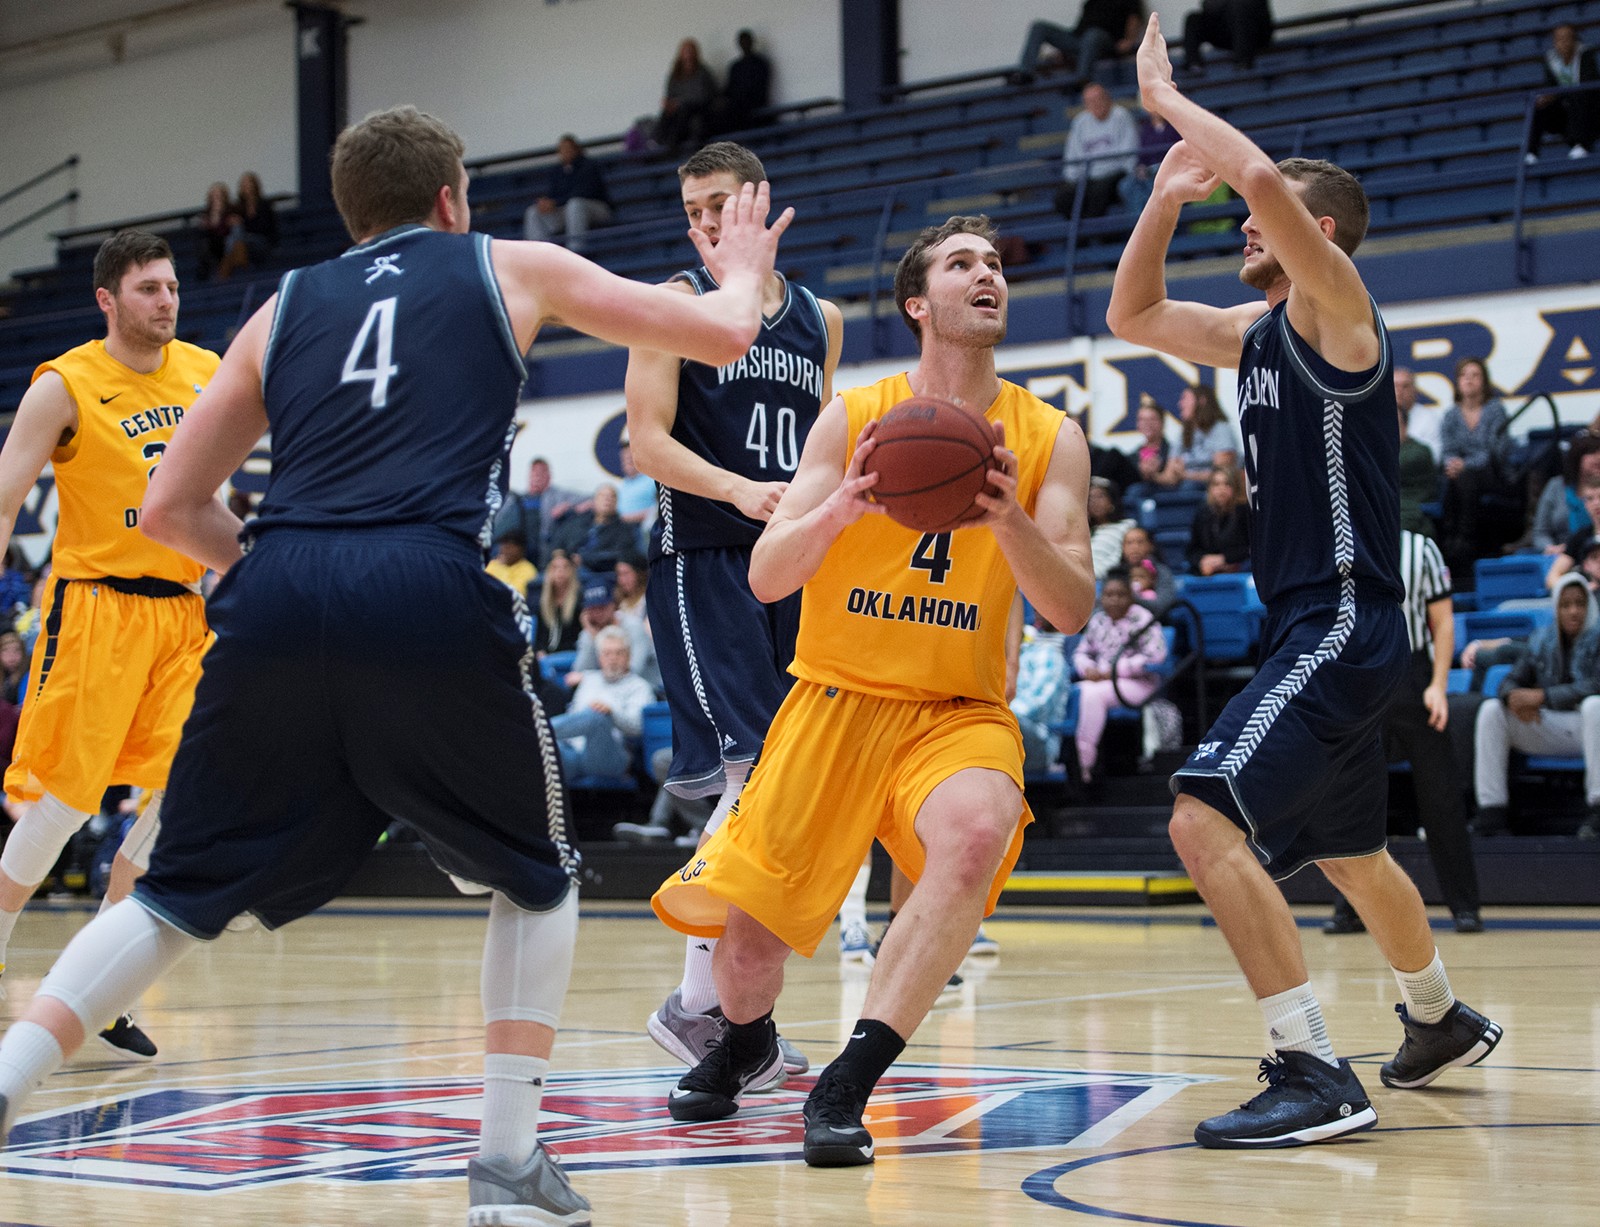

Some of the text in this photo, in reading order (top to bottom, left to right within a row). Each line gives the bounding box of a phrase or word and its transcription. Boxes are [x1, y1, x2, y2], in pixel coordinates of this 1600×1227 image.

[341, 296, 398, 407] 4
[717, 345, 823, 402] WASHBURN
[746, 402, 798, 471] 40
[909, 530, 953, 585] 4
[846, 587, 982, 632] OKLAHOM
